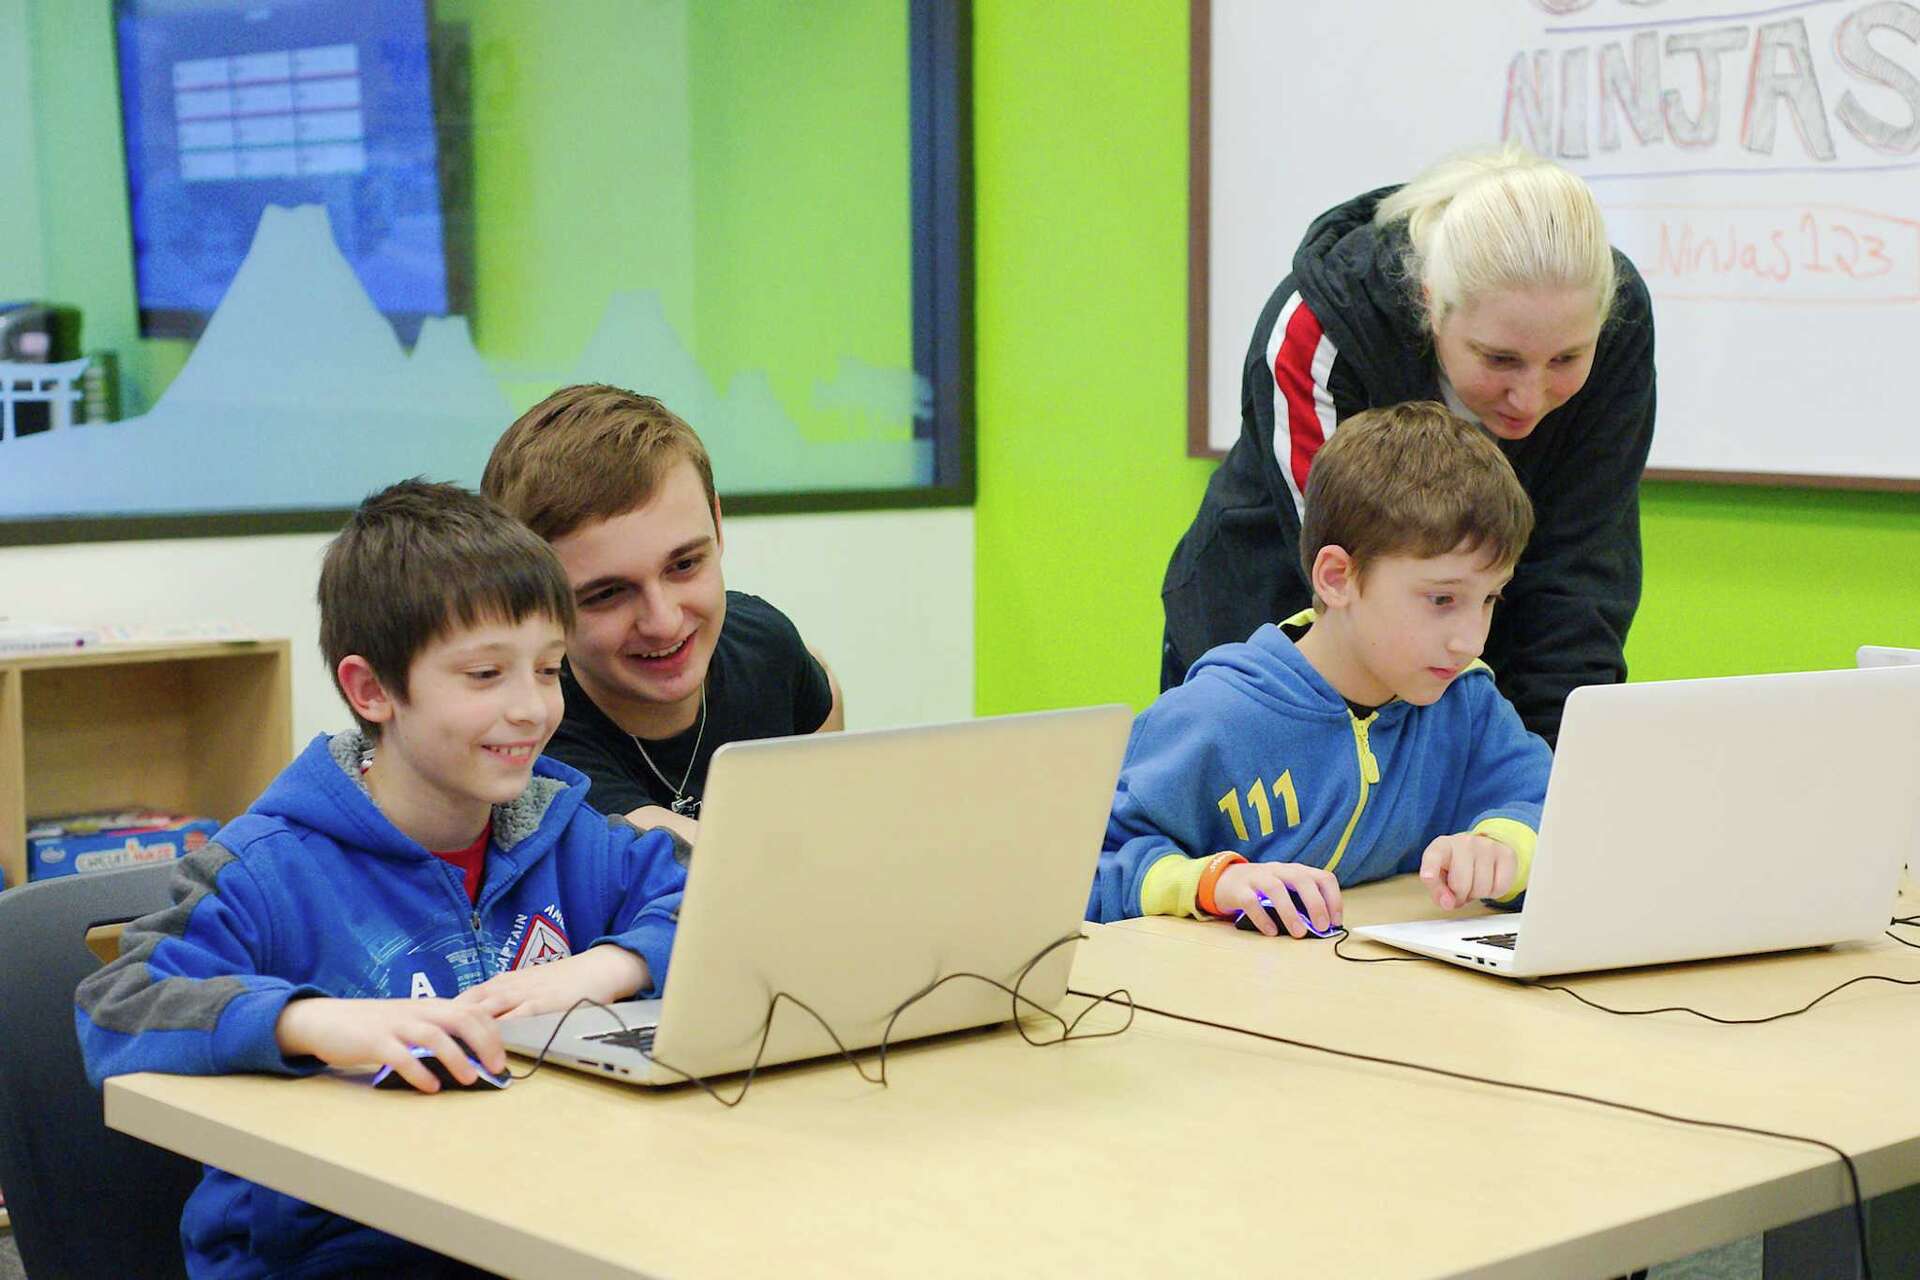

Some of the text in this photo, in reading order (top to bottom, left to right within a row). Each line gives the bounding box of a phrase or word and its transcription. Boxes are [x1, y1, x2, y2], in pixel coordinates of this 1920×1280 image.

[1502, 1, 1920, 163] NINJAS
[1217, 768, 1300, 841] 111
[411, 972, 437, 1000] A
